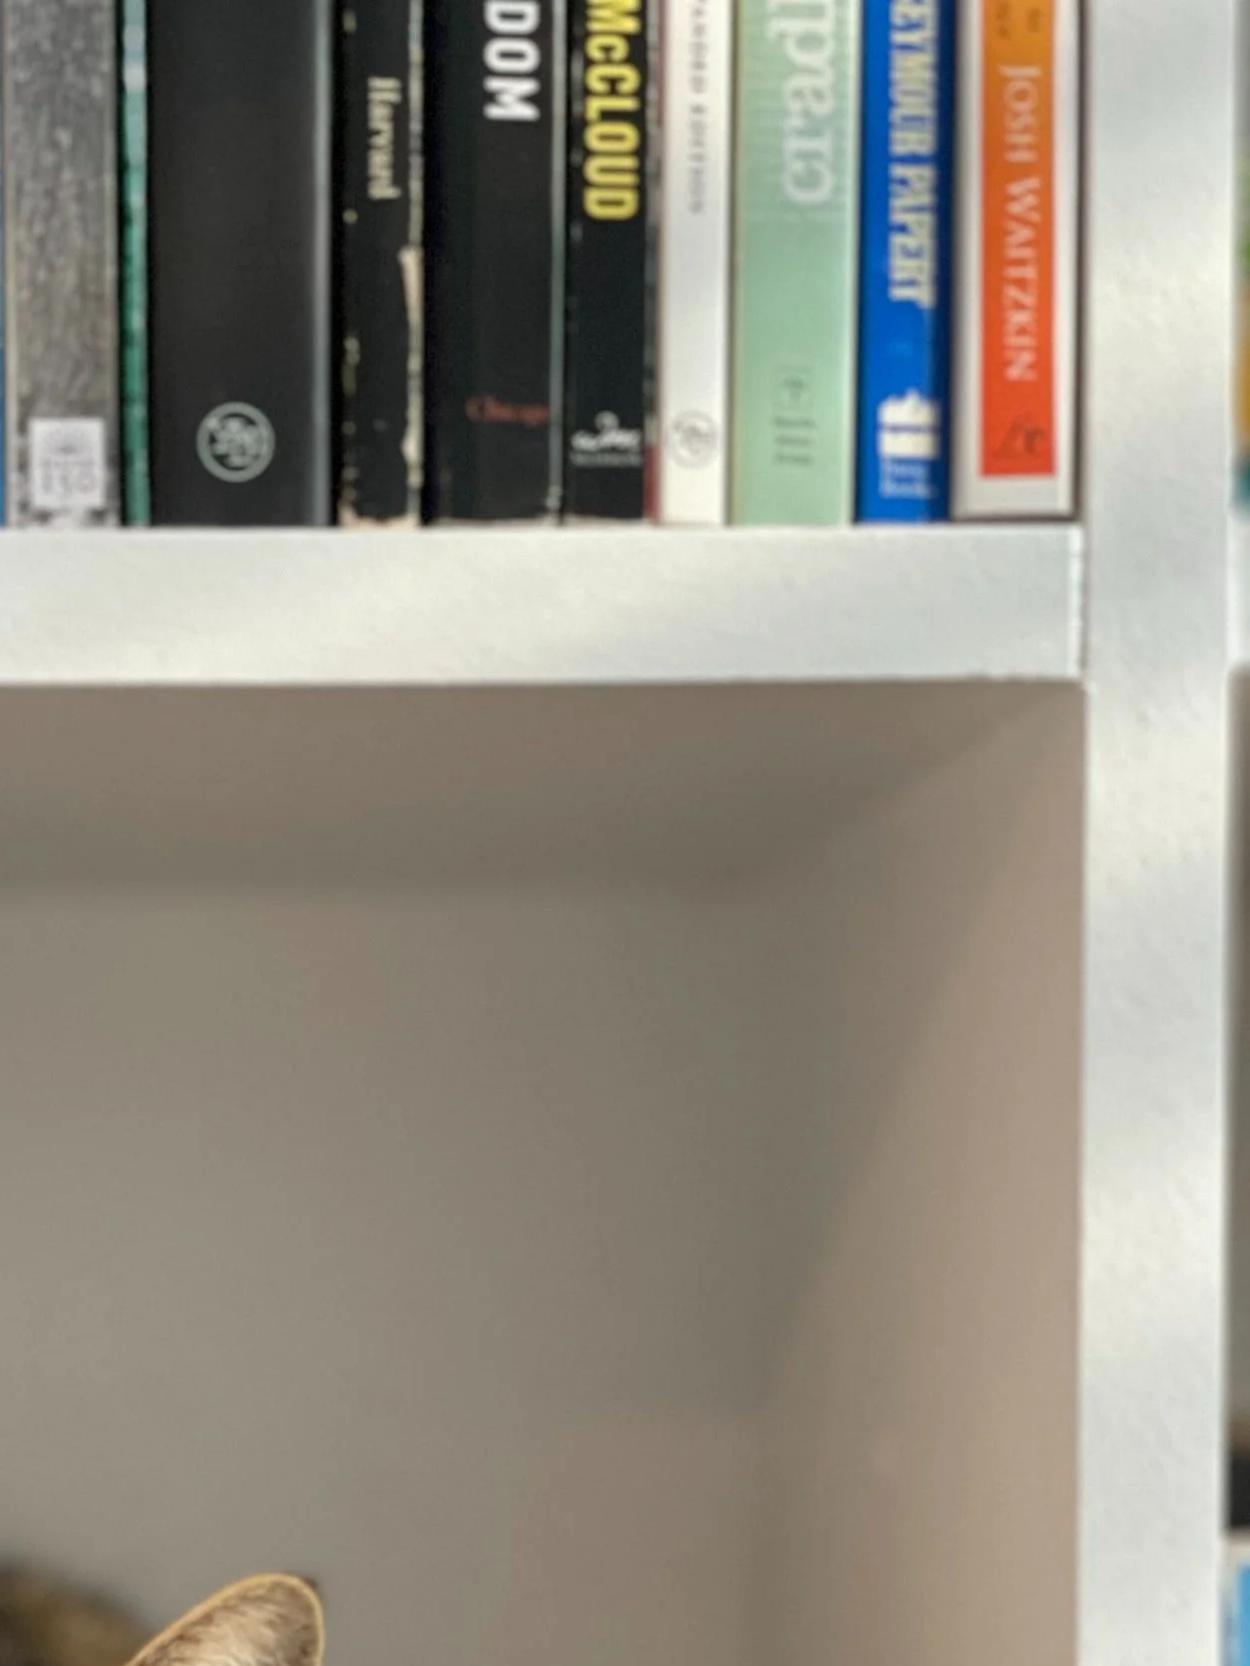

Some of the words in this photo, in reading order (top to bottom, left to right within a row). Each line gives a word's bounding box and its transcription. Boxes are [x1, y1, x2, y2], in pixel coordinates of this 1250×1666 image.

[483, 0, 541, 121] DOM
[583, 0, 641, 221] McCLOUD
[888, 0, 939, 156] EYMOUR
[997, 64, 1043, 163] JOSH
[367, 77, 402, 200] Harvard
[888, 163, 938, 309] PAPERT
[1001, 177, 1043, 382] WAITZKIN
